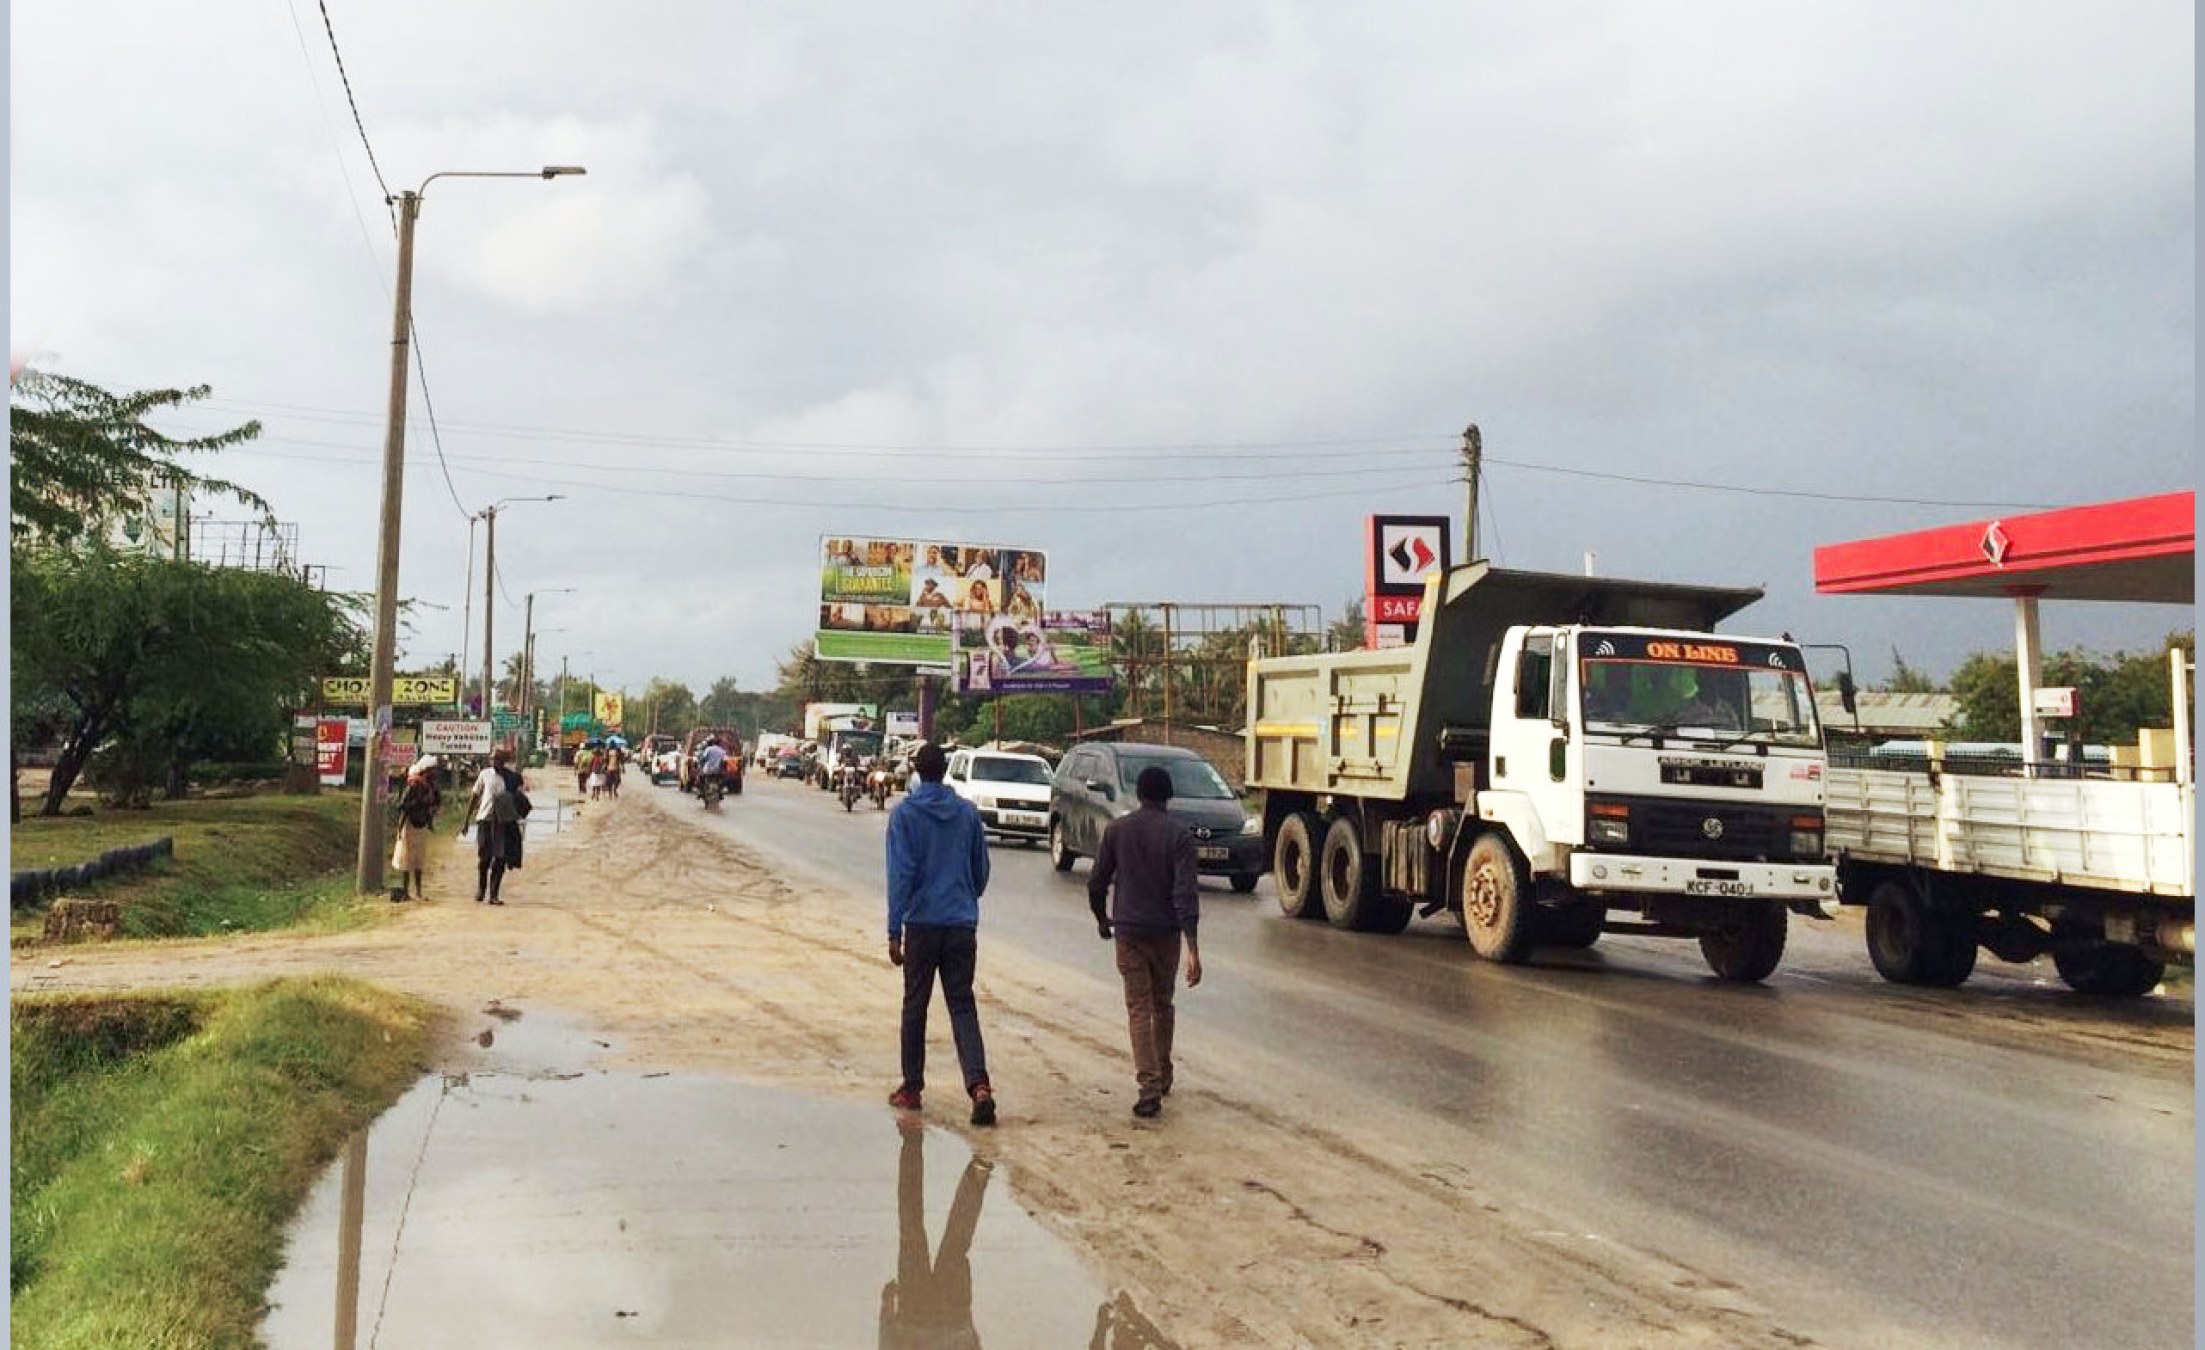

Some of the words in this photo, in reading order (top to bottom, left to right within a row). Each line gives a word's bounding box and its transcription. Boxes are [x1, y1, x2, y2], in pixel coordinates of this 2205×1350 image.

[1647, 642, 1681, 659] ON
[1683, 644, 1739, 663] LINE
[403, 680, 450, 693] ZONE
[436, 723, 478, 732] CAUTION
[426, 733, 452, 742] Heavy
[440, 742, 472, 751] Turning
